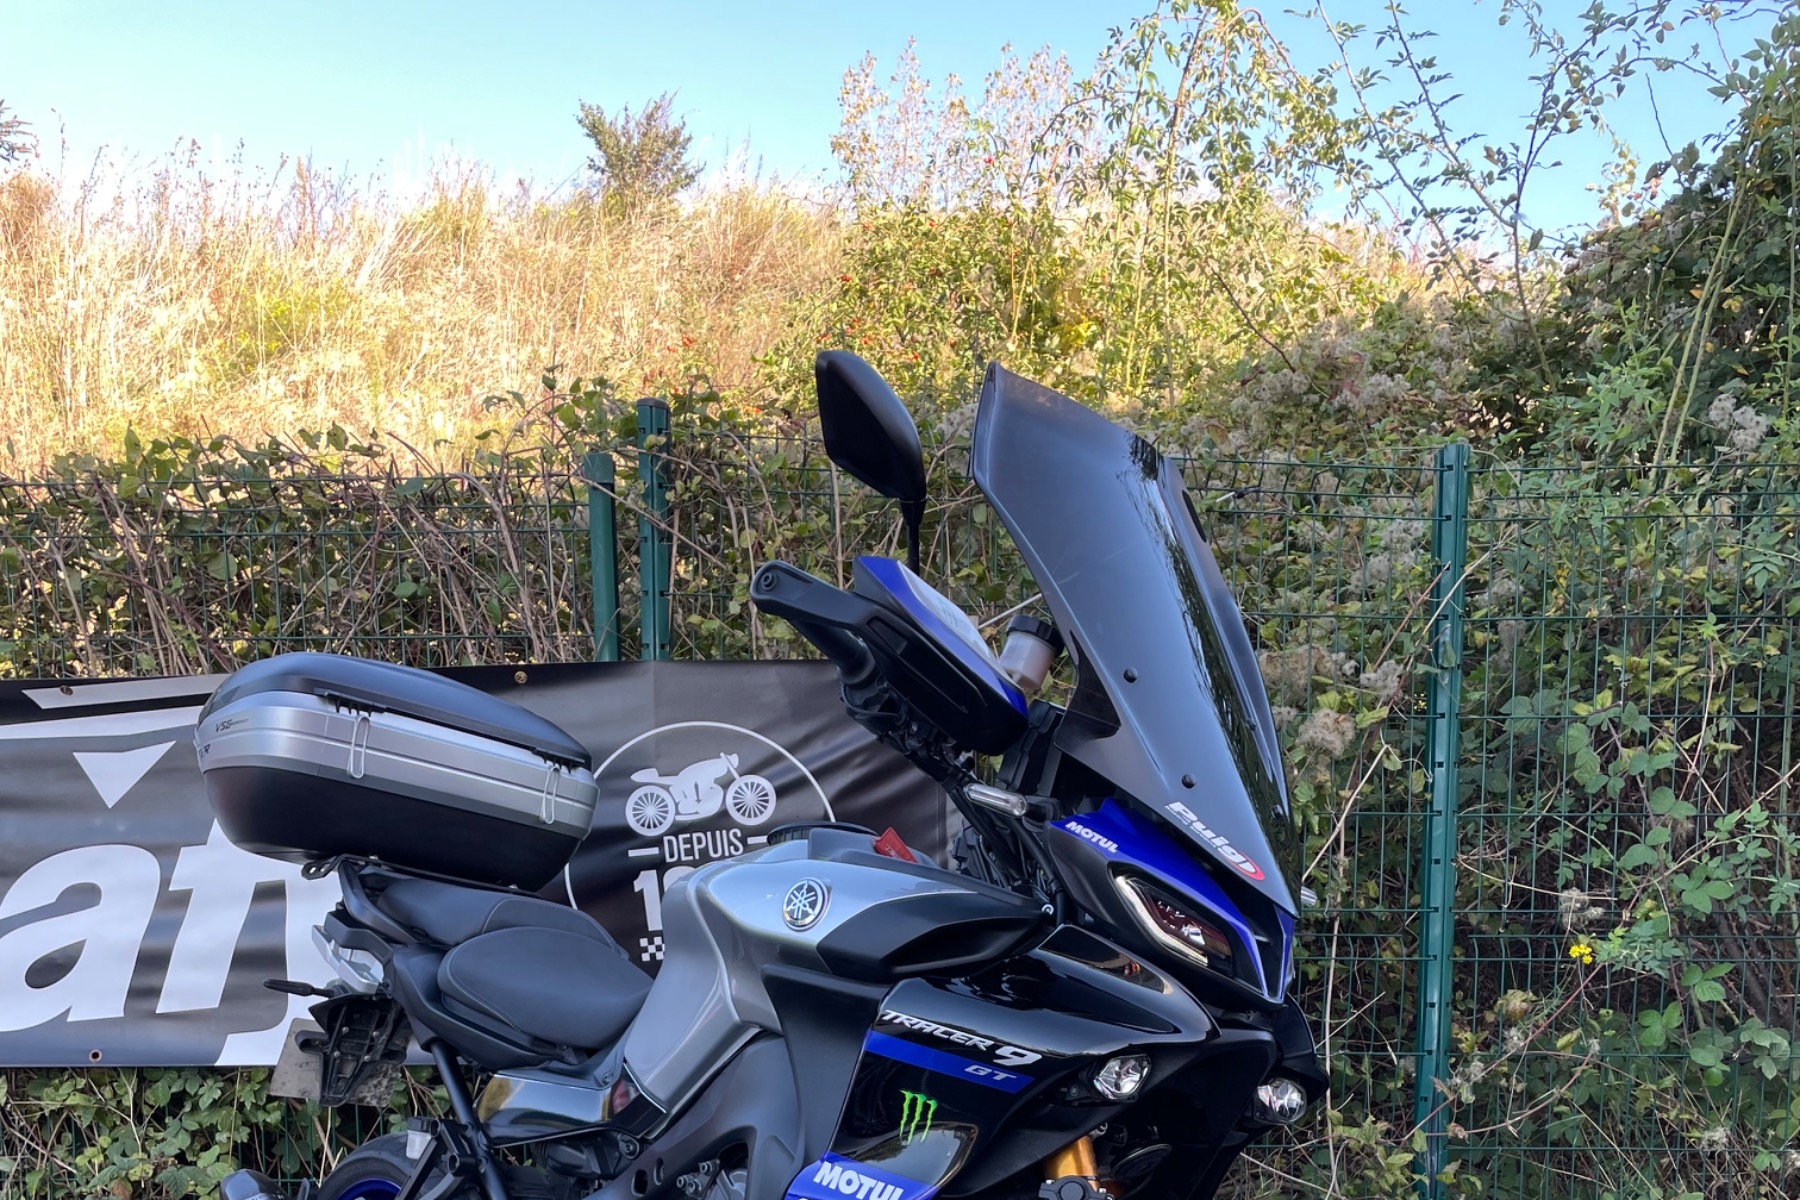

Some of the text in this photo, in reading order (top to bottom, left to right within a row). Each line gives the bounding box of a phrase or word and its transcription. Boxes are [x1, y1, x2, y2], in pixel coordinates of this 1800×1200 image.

[663, 829, 744, 862] DEPUIS
[1065, 821, 1118, 853] MOTUL
[1167, 801, 1257, 873] Puig
[881, 1010, 1042, 1066] TRACER 9
[964, 1065, 1017, 1081] GT
